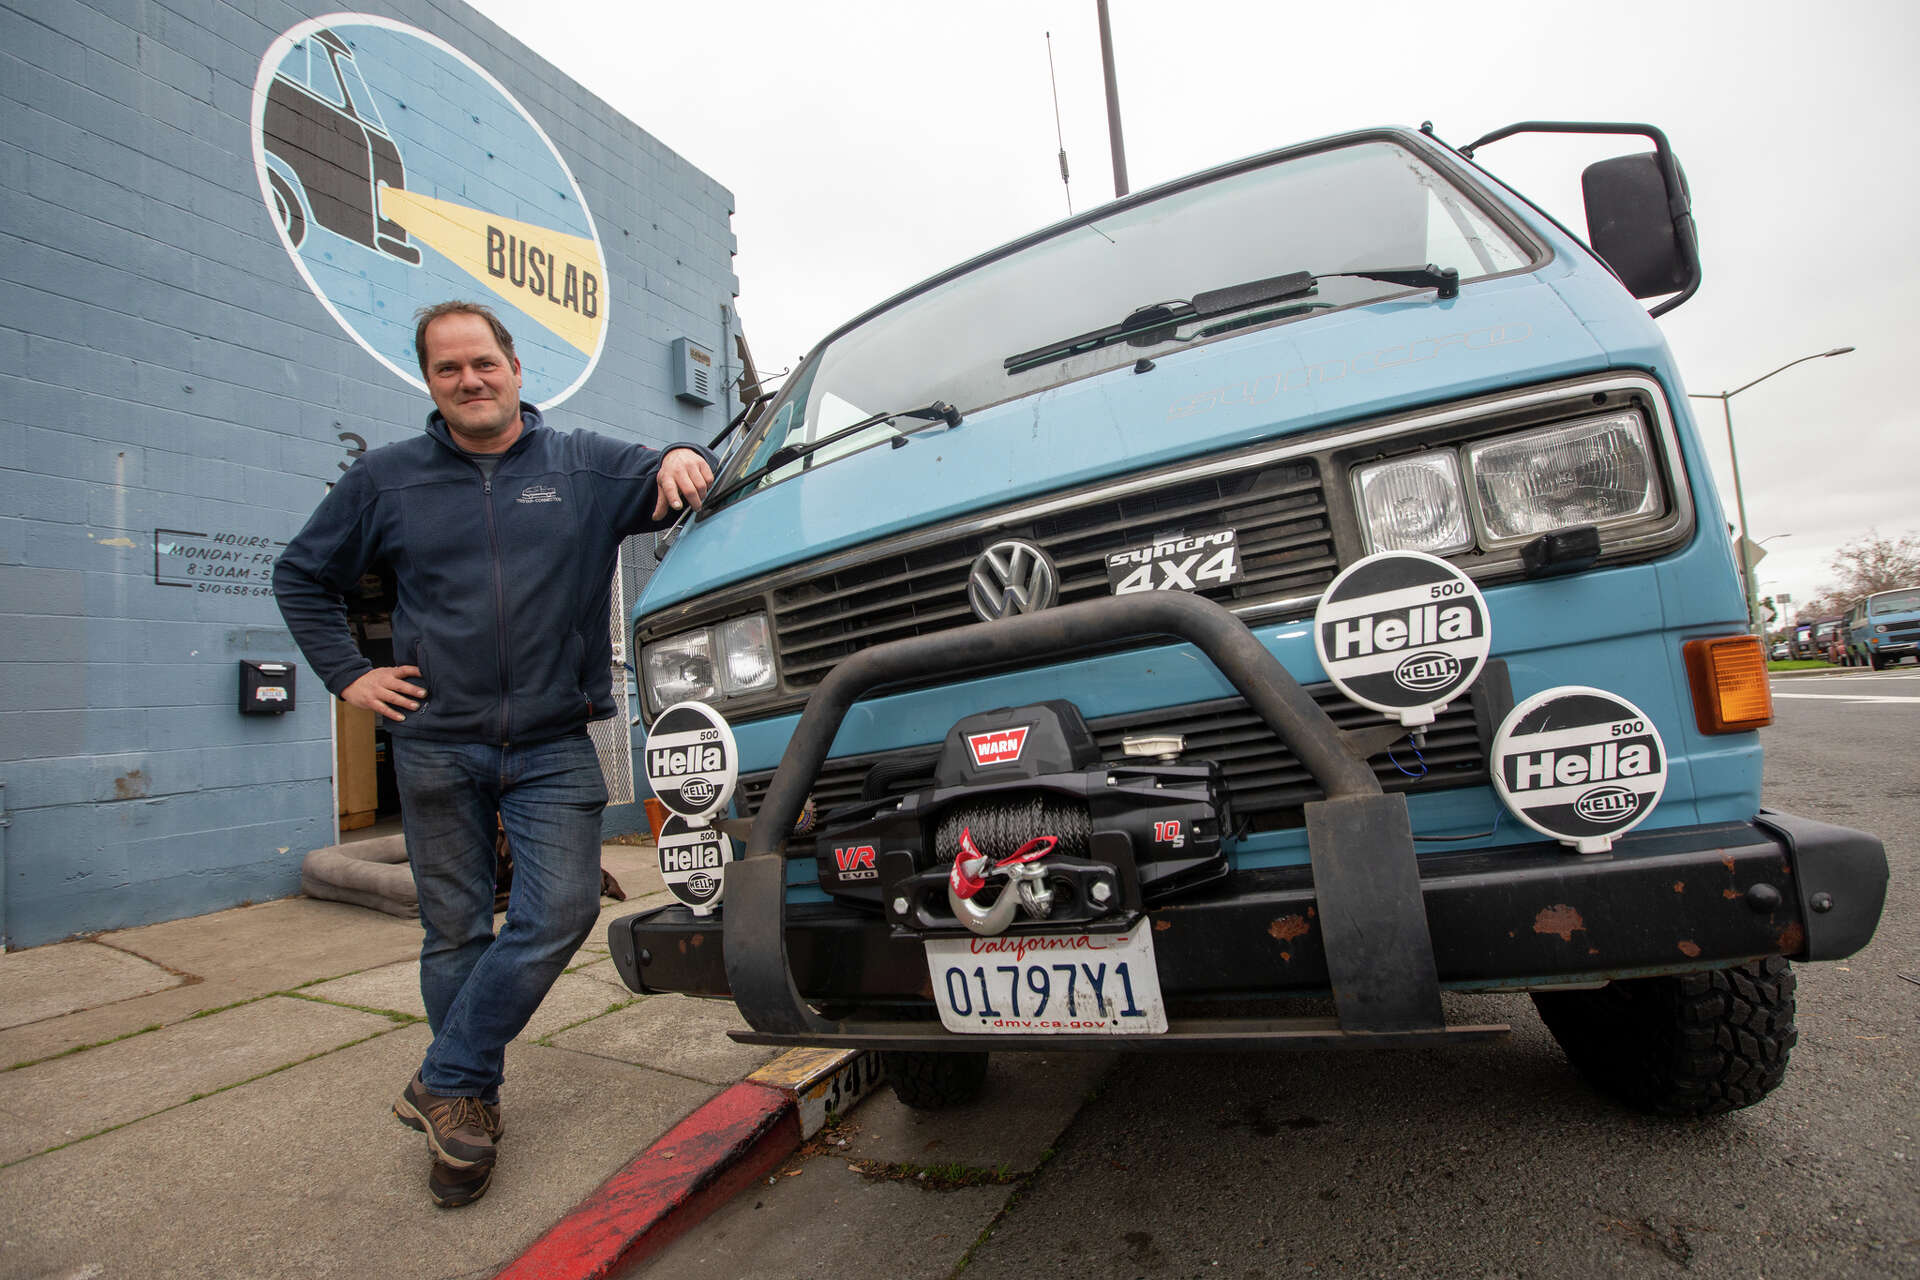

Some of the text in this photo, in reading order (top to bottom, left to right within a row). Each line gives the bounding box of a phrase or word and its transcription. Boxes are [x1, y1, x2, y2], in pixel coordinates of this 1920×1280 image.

[487, 224, 598, 319] BUSLAB
[213, 532, 270, 548] HOURS
[1110, 531, 1234, 567] syncro
[1430, 581, 1465, 598] 500
[1335, 605, 1473, 658] Hella
[1400, 656, 1459, 680] HELLA
[699, 730, 719, 741] 500
[1611, 720, 1645, 736] 500
[978, 739, 1018, 756] WARN
[652, 745, 721, 776] Hella
[1516, 743, 1651, 790] Hella
[683, 783, 714, 797] HELLA
[1579, 794, 1638, 812] HELLA
[700, 832, 715, 841] 500
[664, 844, 718, 872] Hella
[835, 846, 876, 871] VR
[689, 879, 714, 889] HELLA
[841, 871, 876, 880] EVO
[945, 962, 1148, 1018] 01797Y1
[993, 1019, 1106, 1029] dmv.ca.gov
